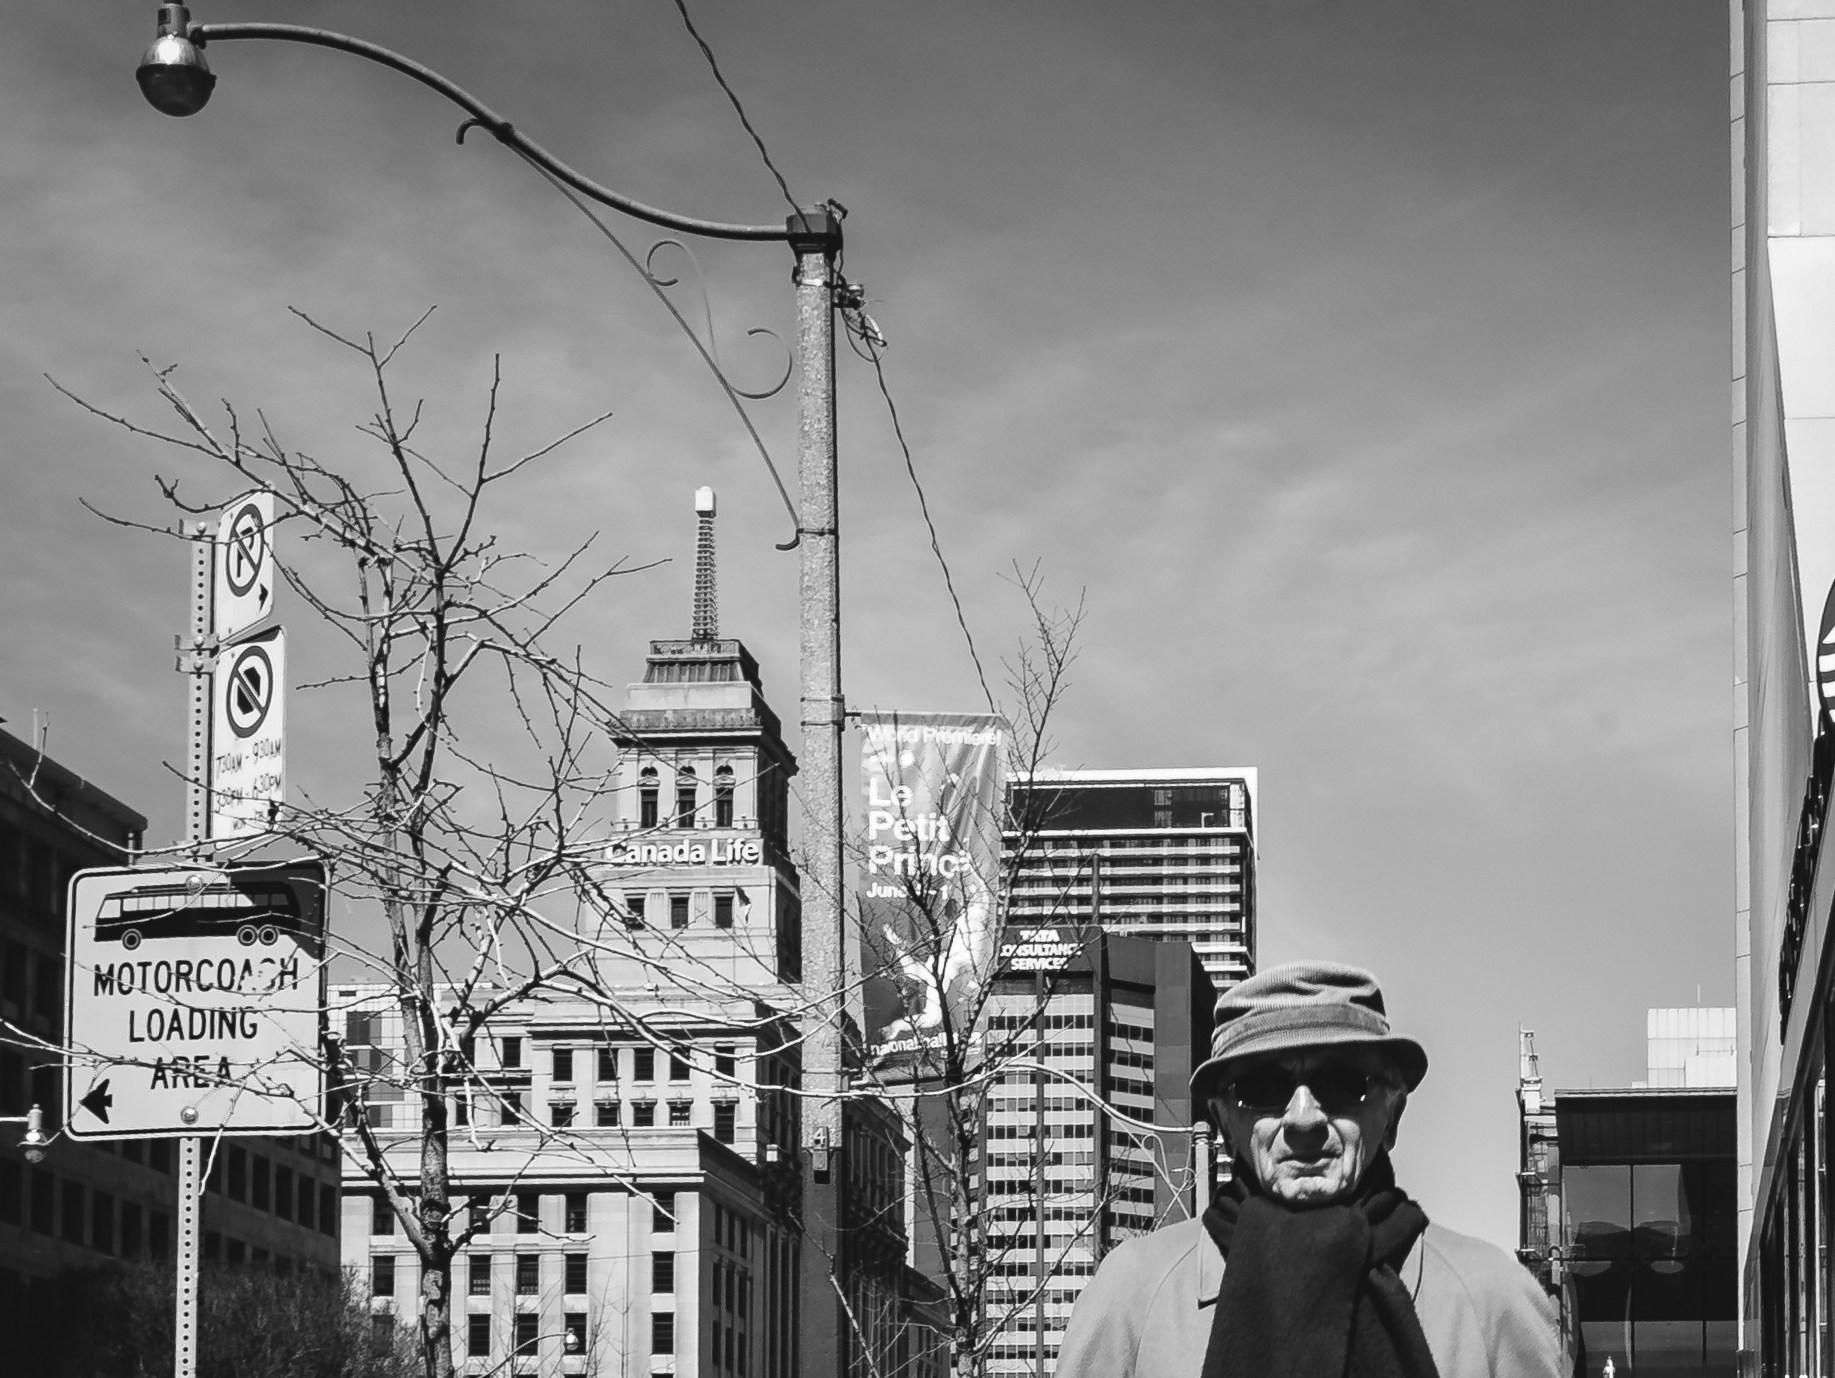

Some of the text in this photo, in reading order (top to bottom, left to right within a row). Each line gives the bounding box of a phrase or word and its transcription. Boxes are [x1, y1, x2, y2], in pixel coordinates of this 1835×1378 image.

[869, 776, 913, 807] Le
[869, 810, 951, 842] Petit
[604, 837, 760, 863] Canada Life
[1000, 943, 1085, 957] ONSULTANC
[1020, 929, 1060, 943] TATA
[1011, 957, 1069, 970] SERVICES
[129, 1006, 258, 1042] LOADING
[150, 1055, 231, 1090] AREA
